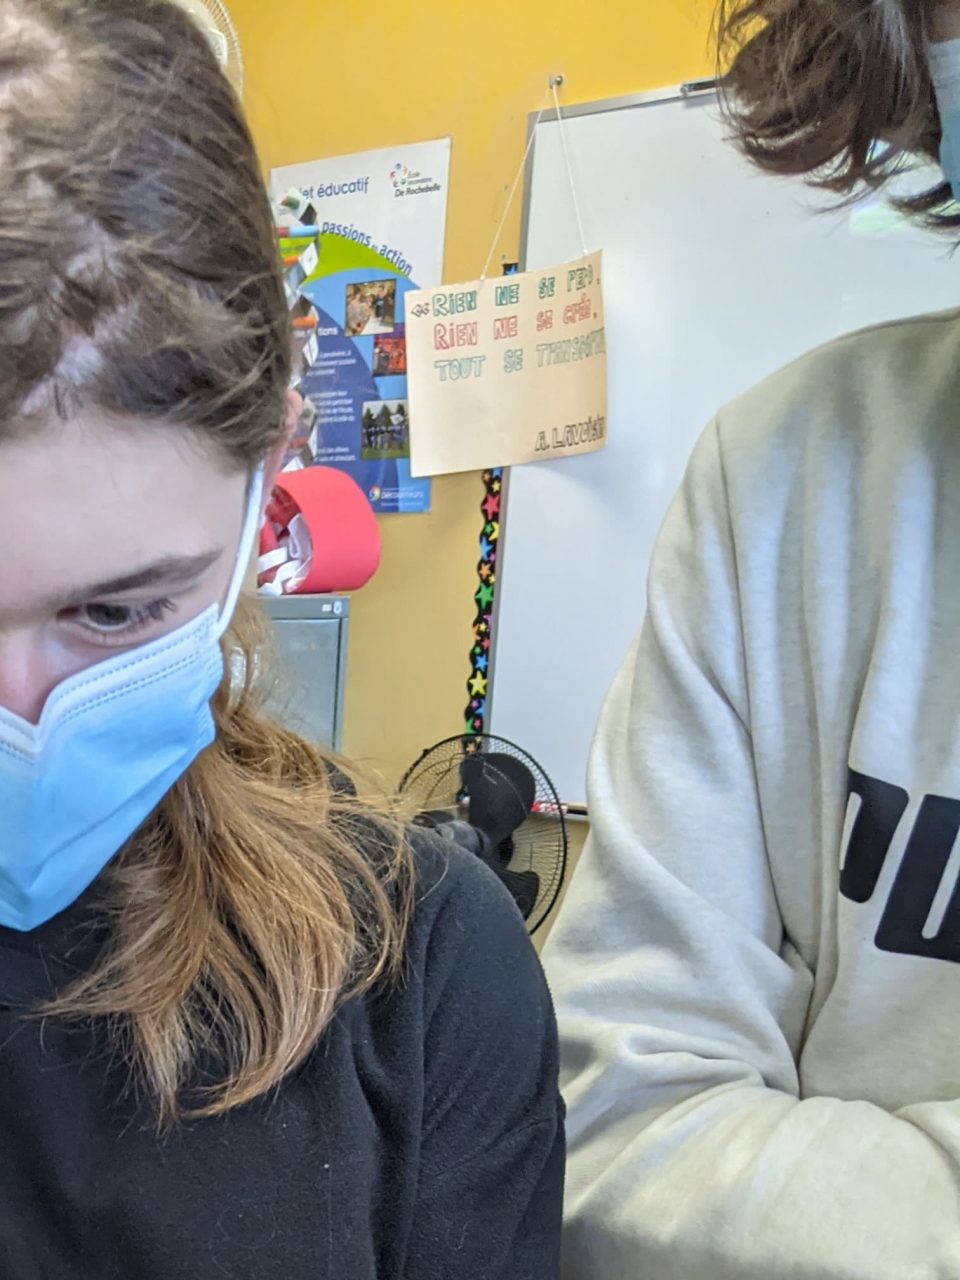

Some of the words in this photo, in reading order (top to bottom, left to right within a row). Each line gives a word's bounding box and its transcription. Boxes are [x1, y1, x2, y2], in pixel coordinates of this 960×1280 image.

[317, 176, 370, 198] éducatif
[321, 221, 372, 248] passions
[379, 244, 413, 277] action
[495, 283, 520, 307] NE
[538, 276, 555, 299] SE
[493, 315, 518, 340] NE
[536, 309, 554, 332] SE
[434, 355, 486, 382] TOUT
[503, 348, 523, 373] SE
